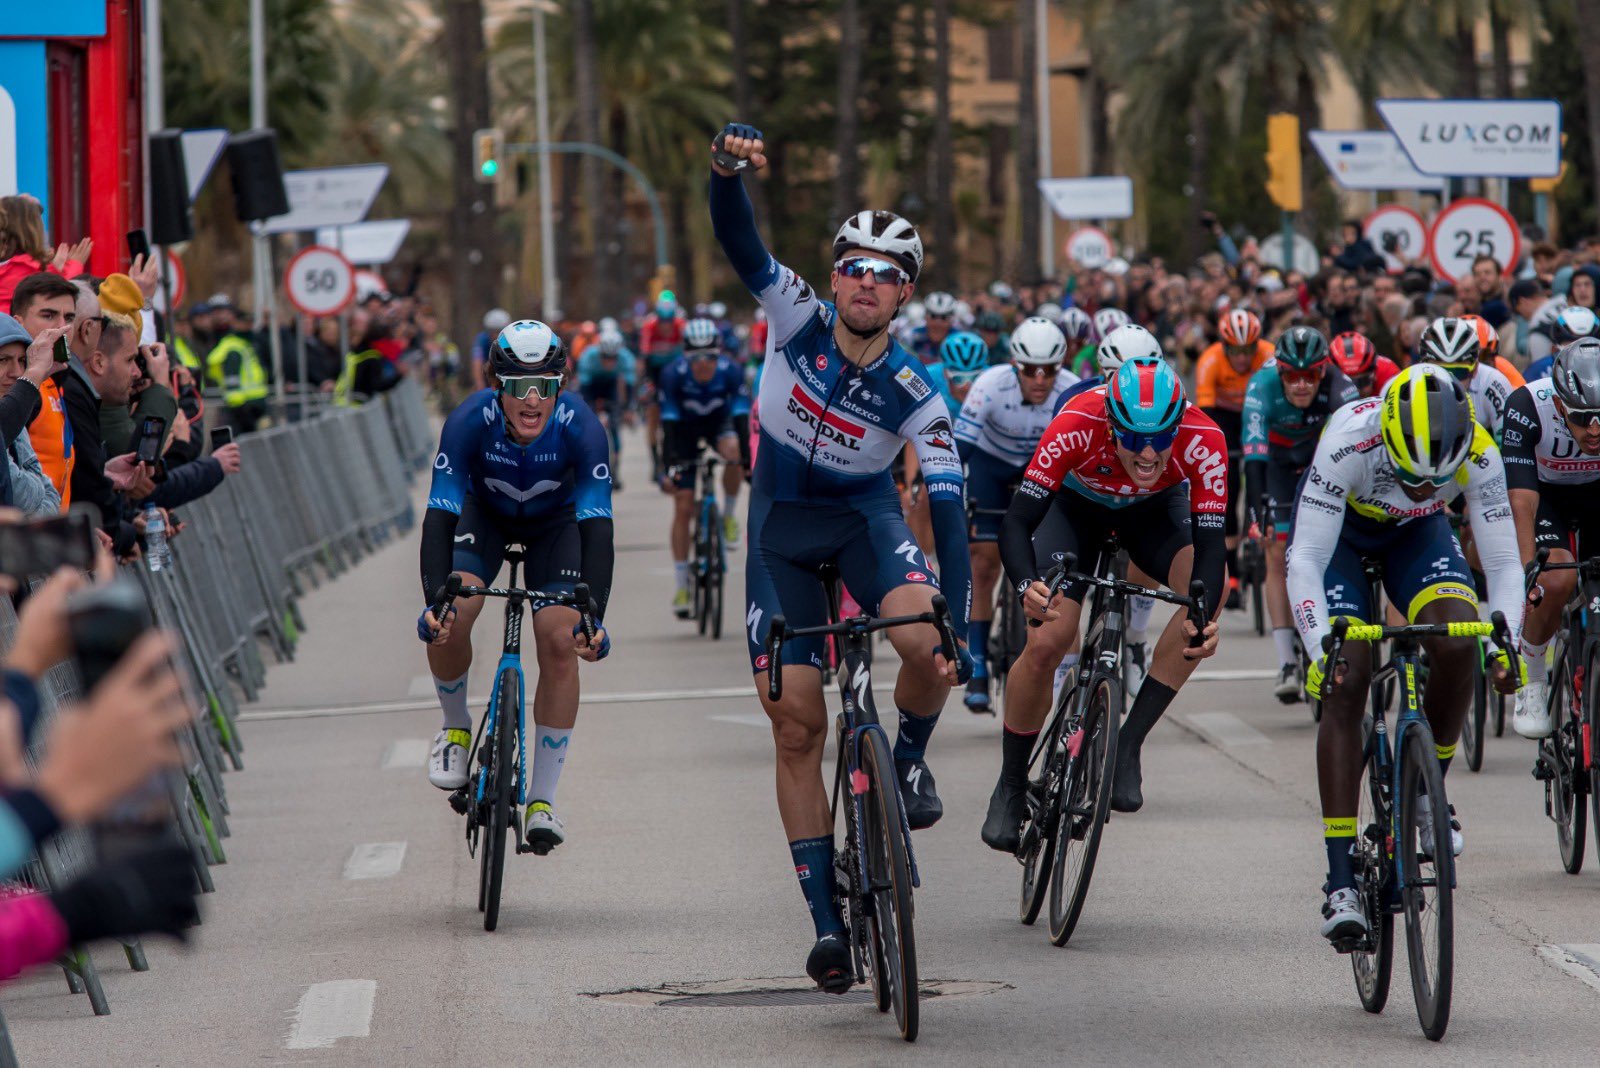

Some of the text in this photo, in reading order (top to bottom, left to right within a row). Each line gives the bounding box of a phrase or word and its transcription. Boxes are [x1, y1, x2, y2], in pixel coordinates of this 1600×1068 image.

[1420, 123, 1552, 143] LUXCOM
[1454, 230, 1495, 259] 25
[305, 269, 336, 294] 50
[864, 351, 889, 373] latexco
[797, 354, 828, 395] Ekopak
[839, 396, 881, 423] latexco
[787, 397, 861, 451] SOUDAL
[1037, 428, 1094, 469] dstny
[1184, 434, 1227, 497] lotto
[1546, 462, 1598, 471] Emira
[1027, 468, 1055, 487] efficy
[1019, 485, 1042, 499] lotto
[1022, 480, 1050, 497] viking
[1197, 500, 1227, 512] efficy
[1197, 513, 1225, 524] viking
[1197, 519, 1223, 528] lotto
[1422, 571, 1467, 582] CUBE
[1328, 602, 1359, 611] UBE
[1405, 662, 1417, 710] CUBE
[1330, 823, 1353, 831] Nalini
